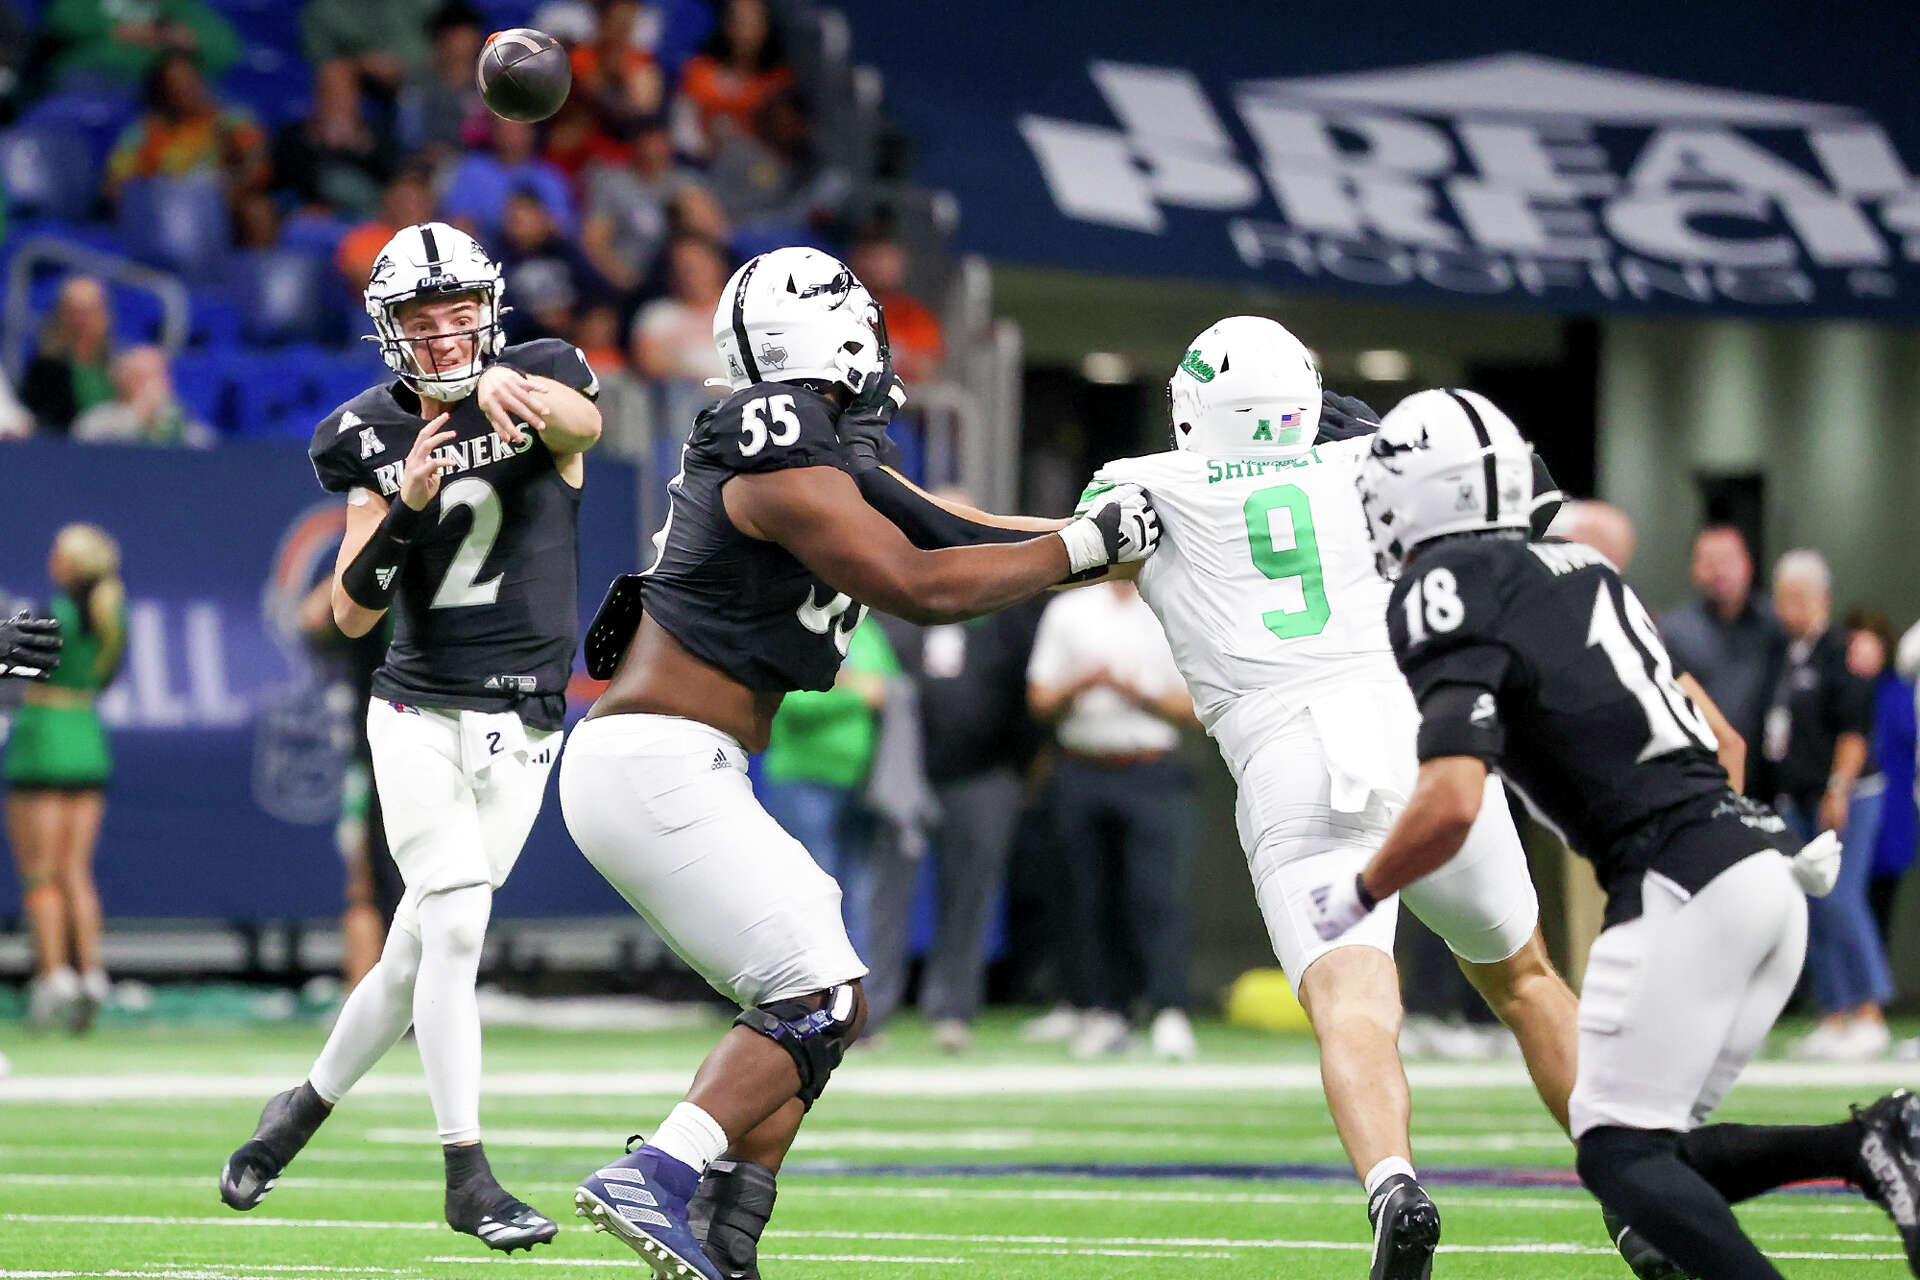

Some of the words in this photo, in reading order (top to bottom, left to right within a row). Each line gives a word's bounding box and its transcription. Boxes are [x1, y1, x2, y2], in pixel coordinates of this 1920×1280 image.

[737, 393, 801, 457] 55
[430, 477, 505, 610] 2
[1243, 483, 1332, 640] 9
[1400, 566, 1465, 649] 18
[1585, 577, 1720, 765] 18
[486, 731, 505, 756] 2
